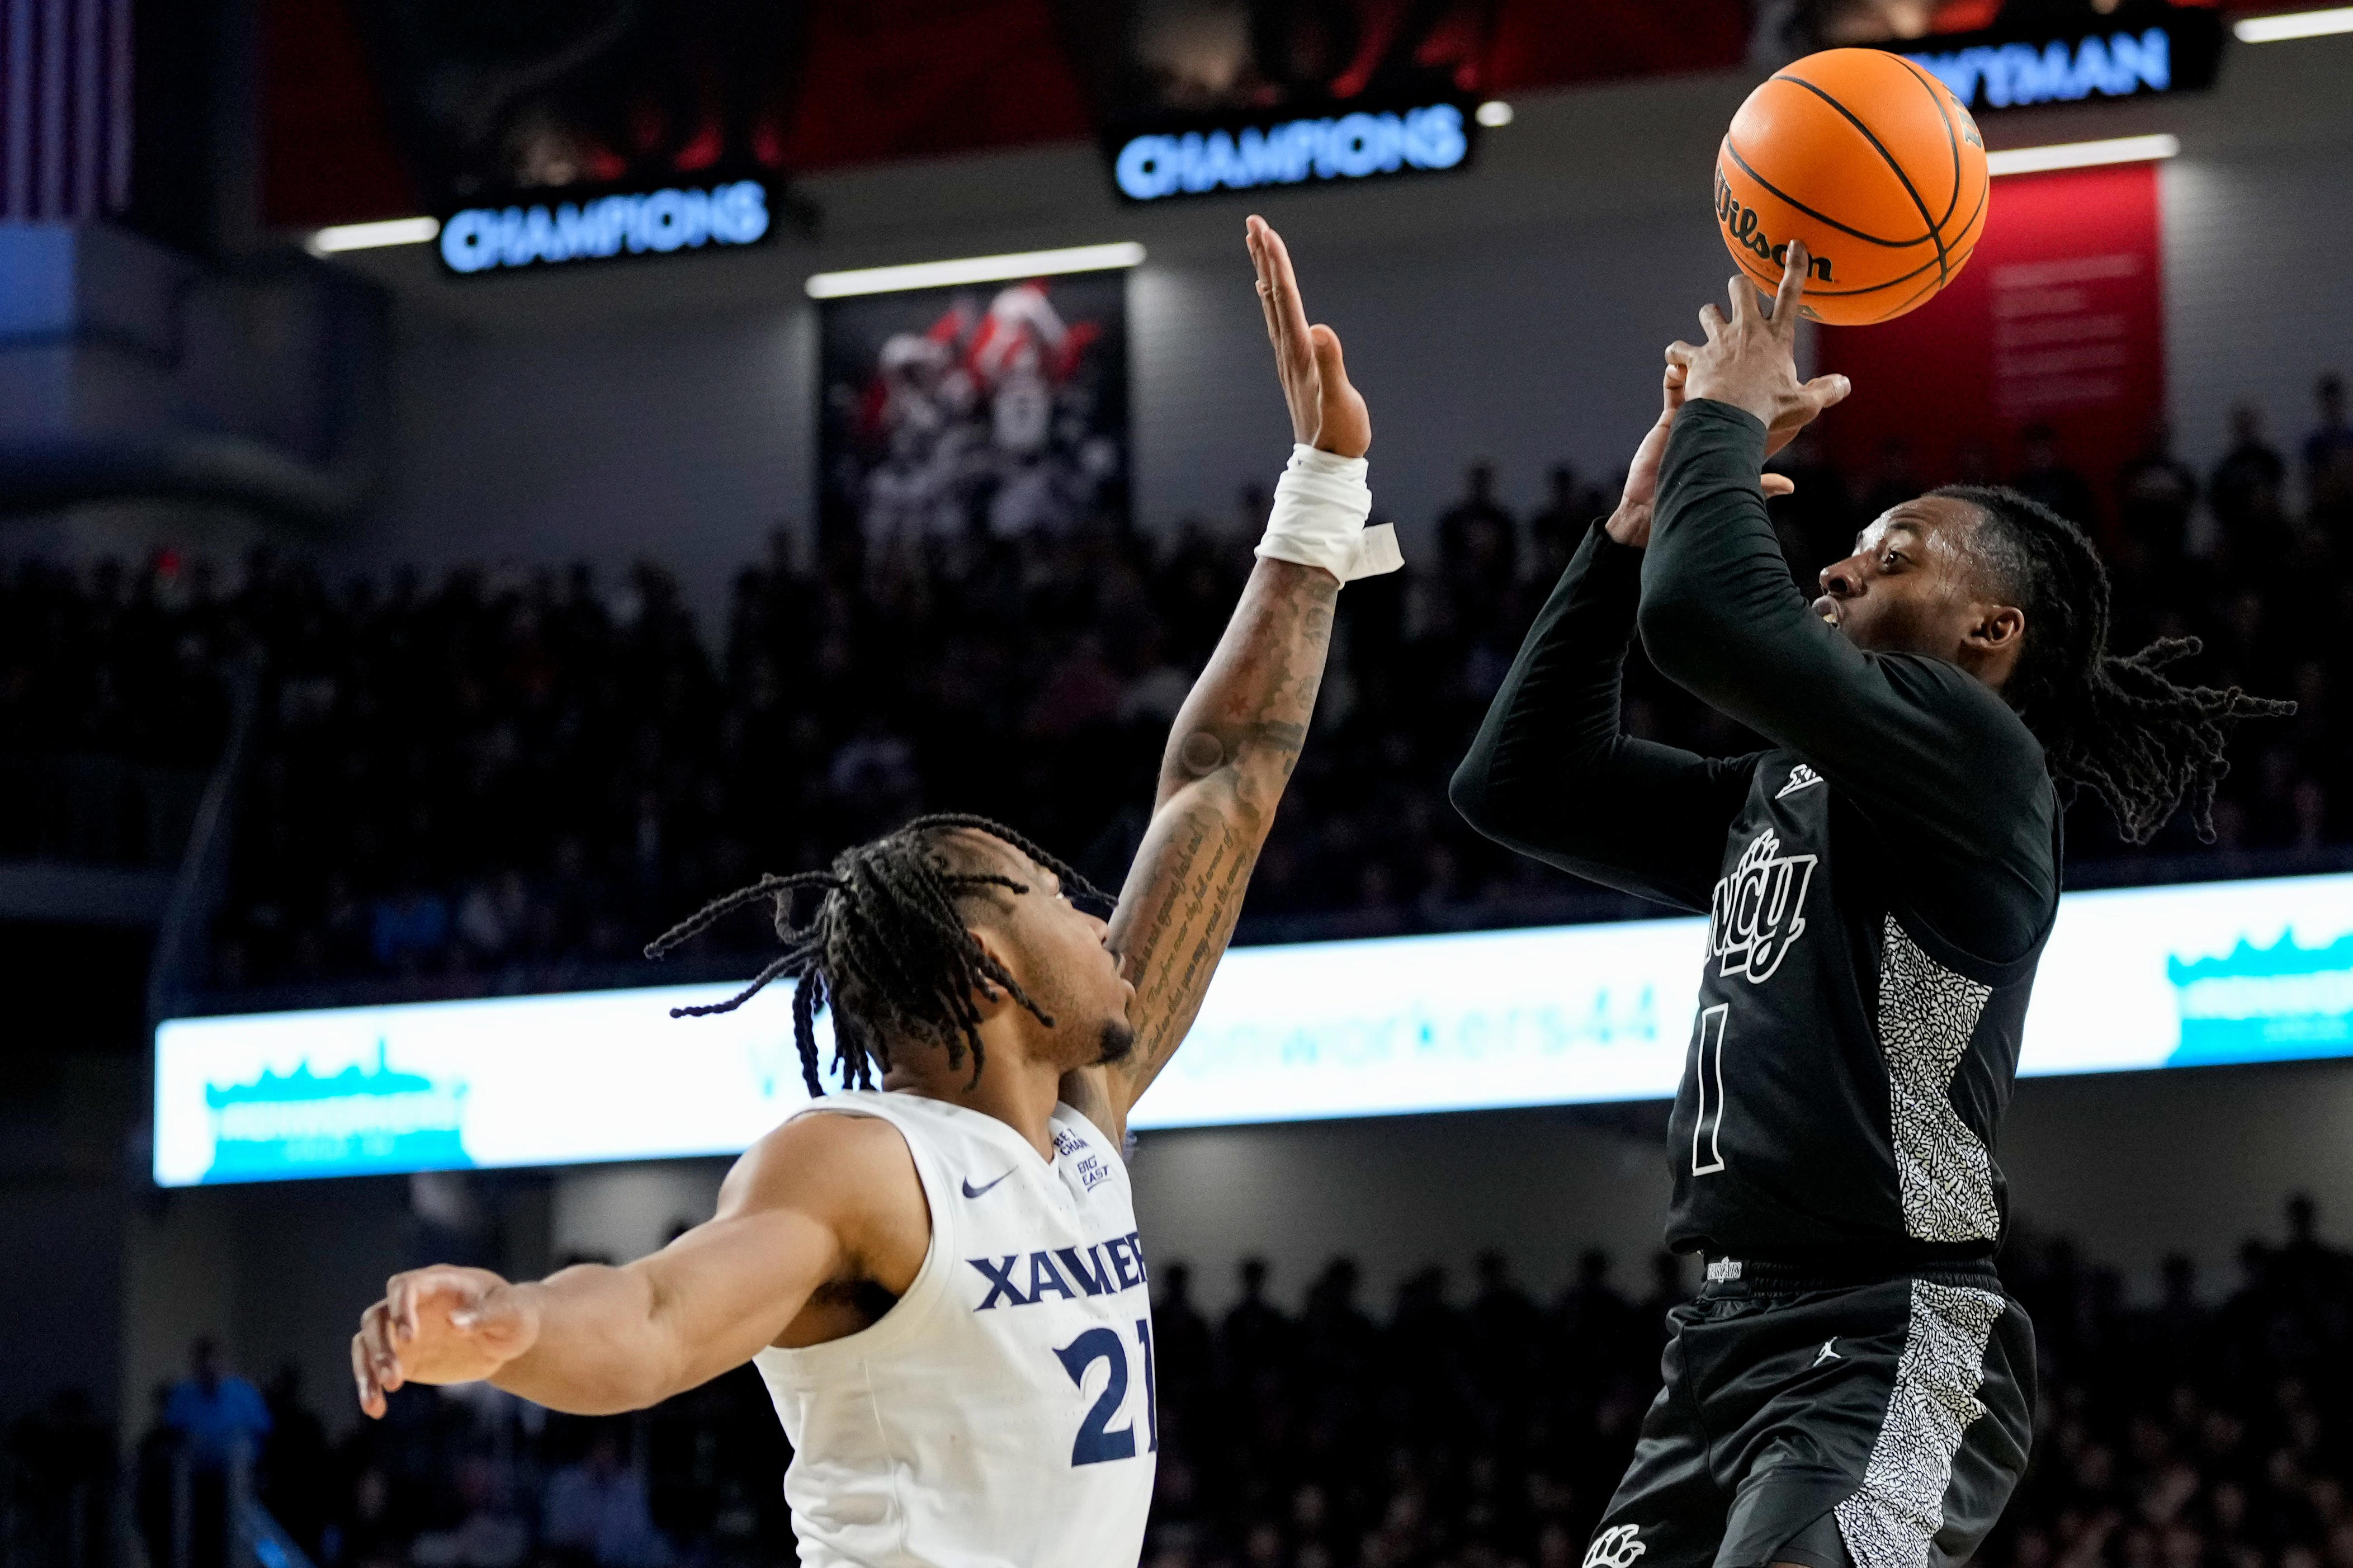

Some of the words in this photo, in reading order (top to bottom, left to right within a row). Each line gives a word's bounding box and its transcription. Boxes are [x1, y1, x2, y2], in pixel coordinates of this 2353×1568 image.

[1116, 104, 1467, 200] CHAMPIONS
[441, 180, 769, 273] CHAMPIONS
[1692, 1003, 1729, 1177] 1
[1078, 1154, 1097, 1174] BIG
[1082, 1165, 1109, 1186] EAST
[1052, 1318, 1158, 1468] 21
